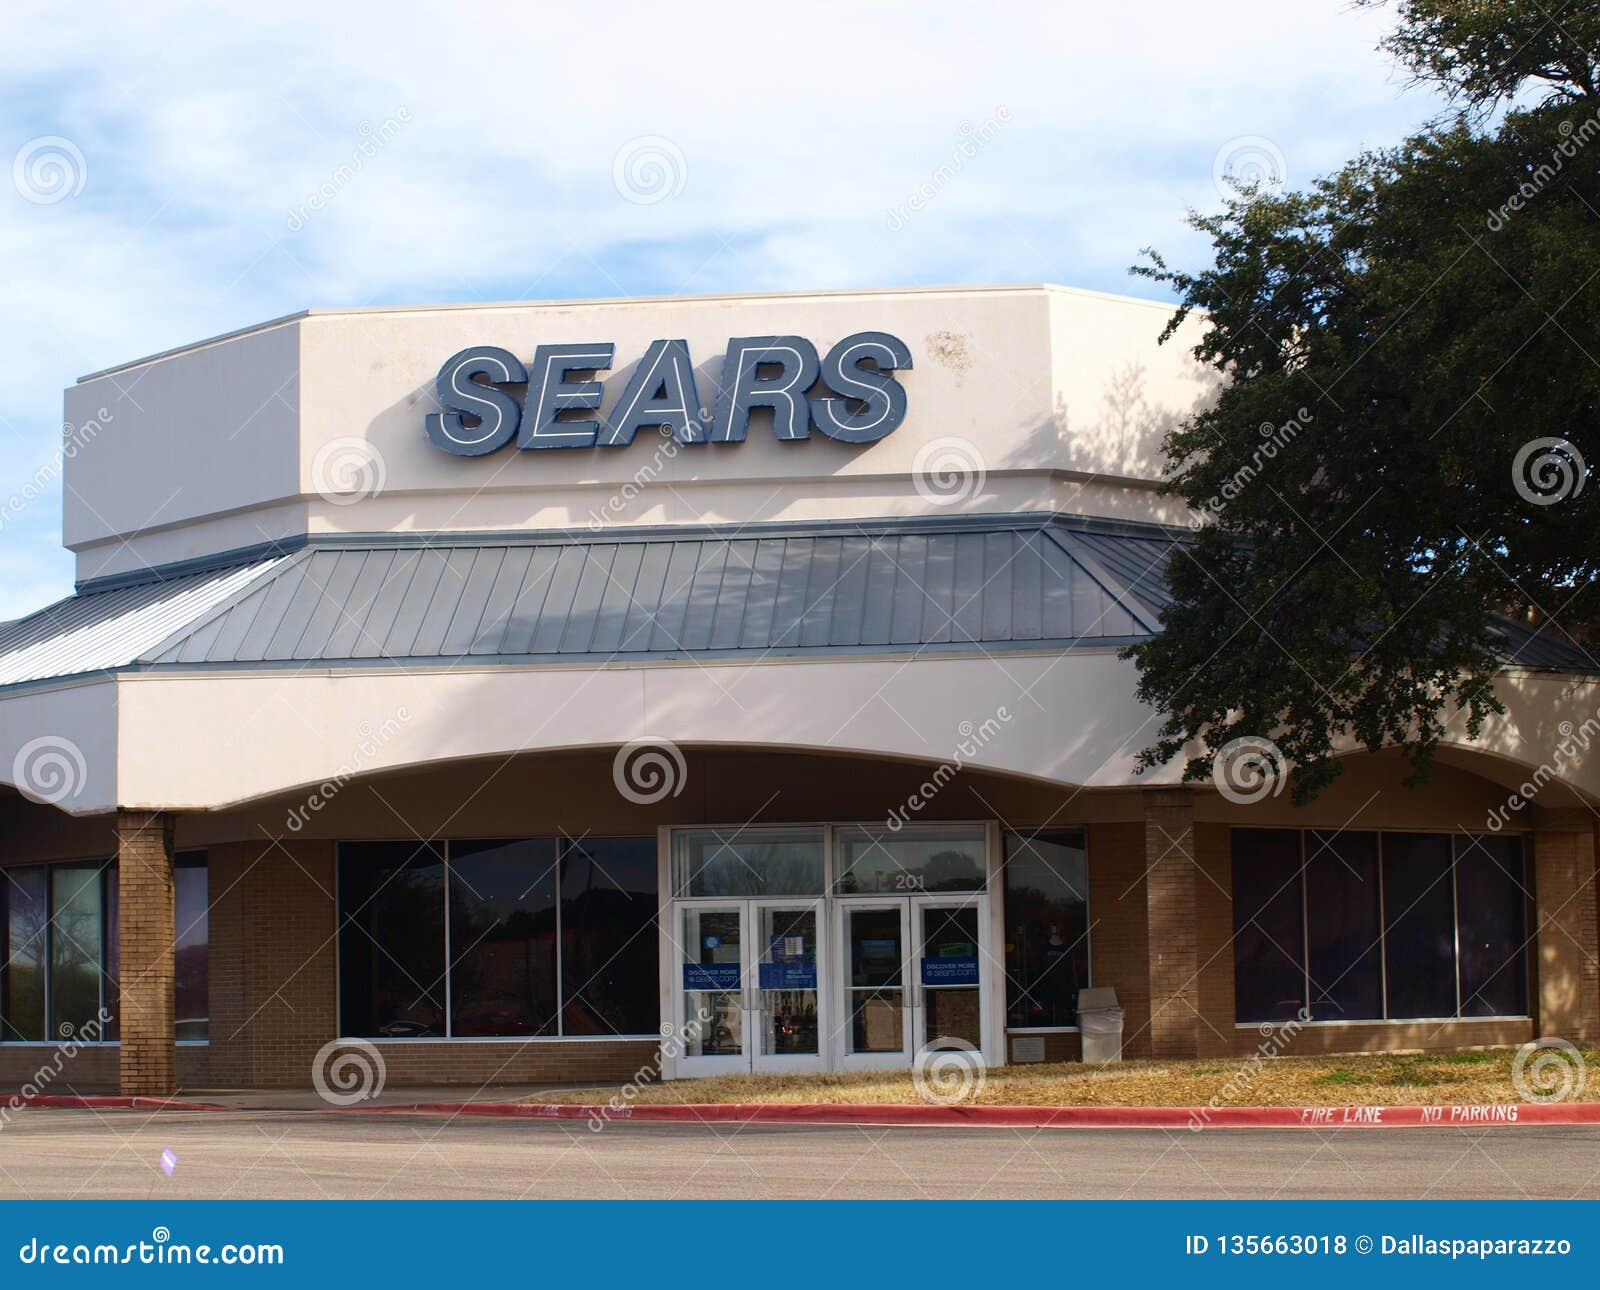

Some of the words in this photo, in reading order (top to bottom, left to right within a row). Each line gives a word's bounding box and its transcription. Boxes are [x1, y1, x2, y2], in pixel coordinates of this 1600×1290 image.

[425, 331, 913, 456] SEARS
[896, 875, 924, 889] 201
[934, 968, 977, 977] sears.com
[1301, 1108, 1337, 1123] FIRE
[1344, 1106, 1385, 1123] LANE
[1420, 1106, 1442, 1122] NO
[1451, 1105, 1518, 1122] PARKING
